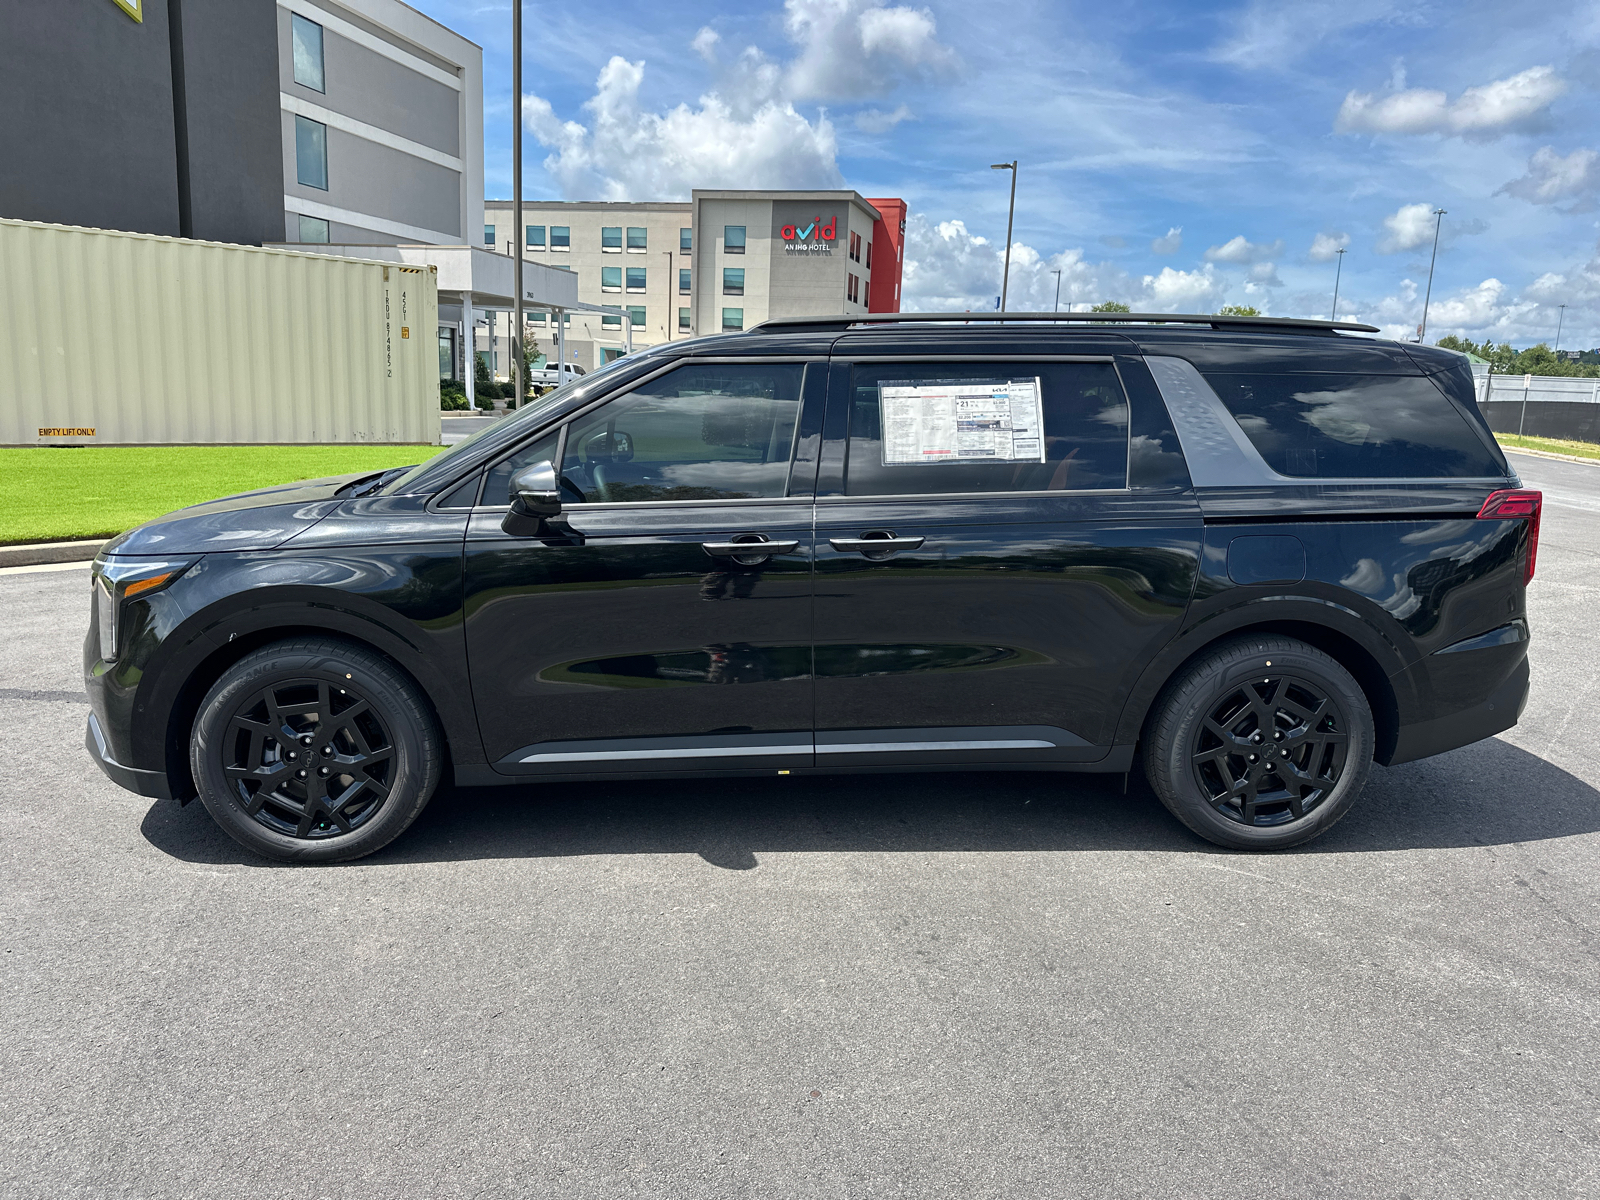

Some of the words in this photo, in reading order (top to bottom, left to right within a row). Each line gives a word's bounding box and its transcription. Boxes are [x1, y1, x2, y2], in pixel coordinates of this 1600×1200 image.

[780, 216, 837, 240] avid
[39, 428, 61, 436] EMPTY
[62, 428, 75, 436] LIFT
[76, 428, 95, 436] ONLY
